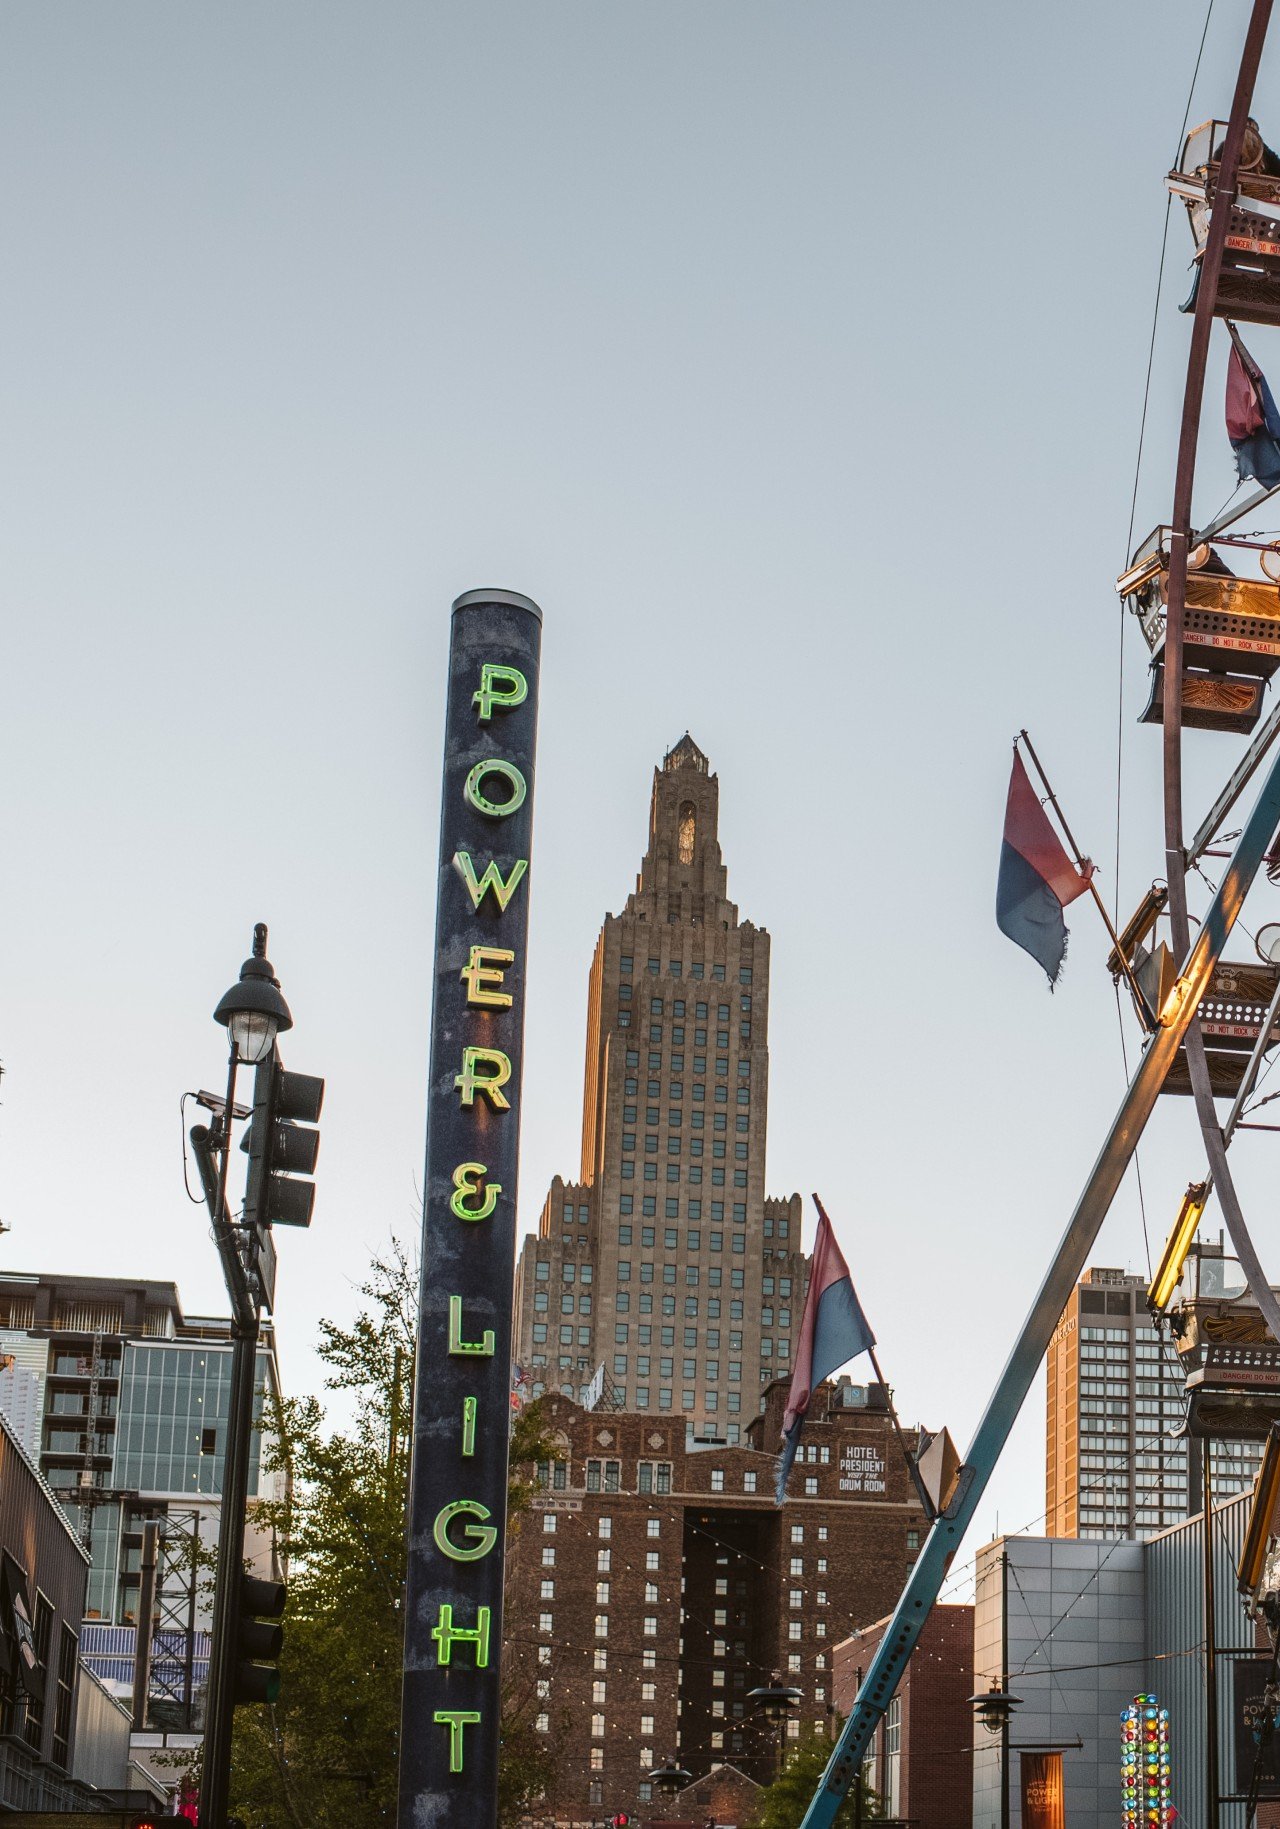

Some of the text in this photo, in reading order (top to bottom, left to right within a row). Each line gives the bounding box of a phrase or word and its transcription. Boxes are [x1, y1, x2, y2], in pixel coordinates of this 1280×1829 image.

[1270, 245, 1280, 254] NOT
[1212, 637, 1220, 645] DO
[1223, 639, 1234, 647] NOT
[1238, 641, 1253, 650] ROCK
[1256, 643, 1271, 652] SEAT
[1218, 1025, 1230, 1034] NOT
[1233, 1027, 1248, 1036] ROCK
[431, 664, 529, 1773] POWER & LIGHT
[1223, 1372, 1253, 1380] DANGER!
[847, 1446, 879, 1459] HOTEL
[840, 1459, 885, 1472] PRESIDENT
[839, 1478, 886, 1492] DRUM ROOM
